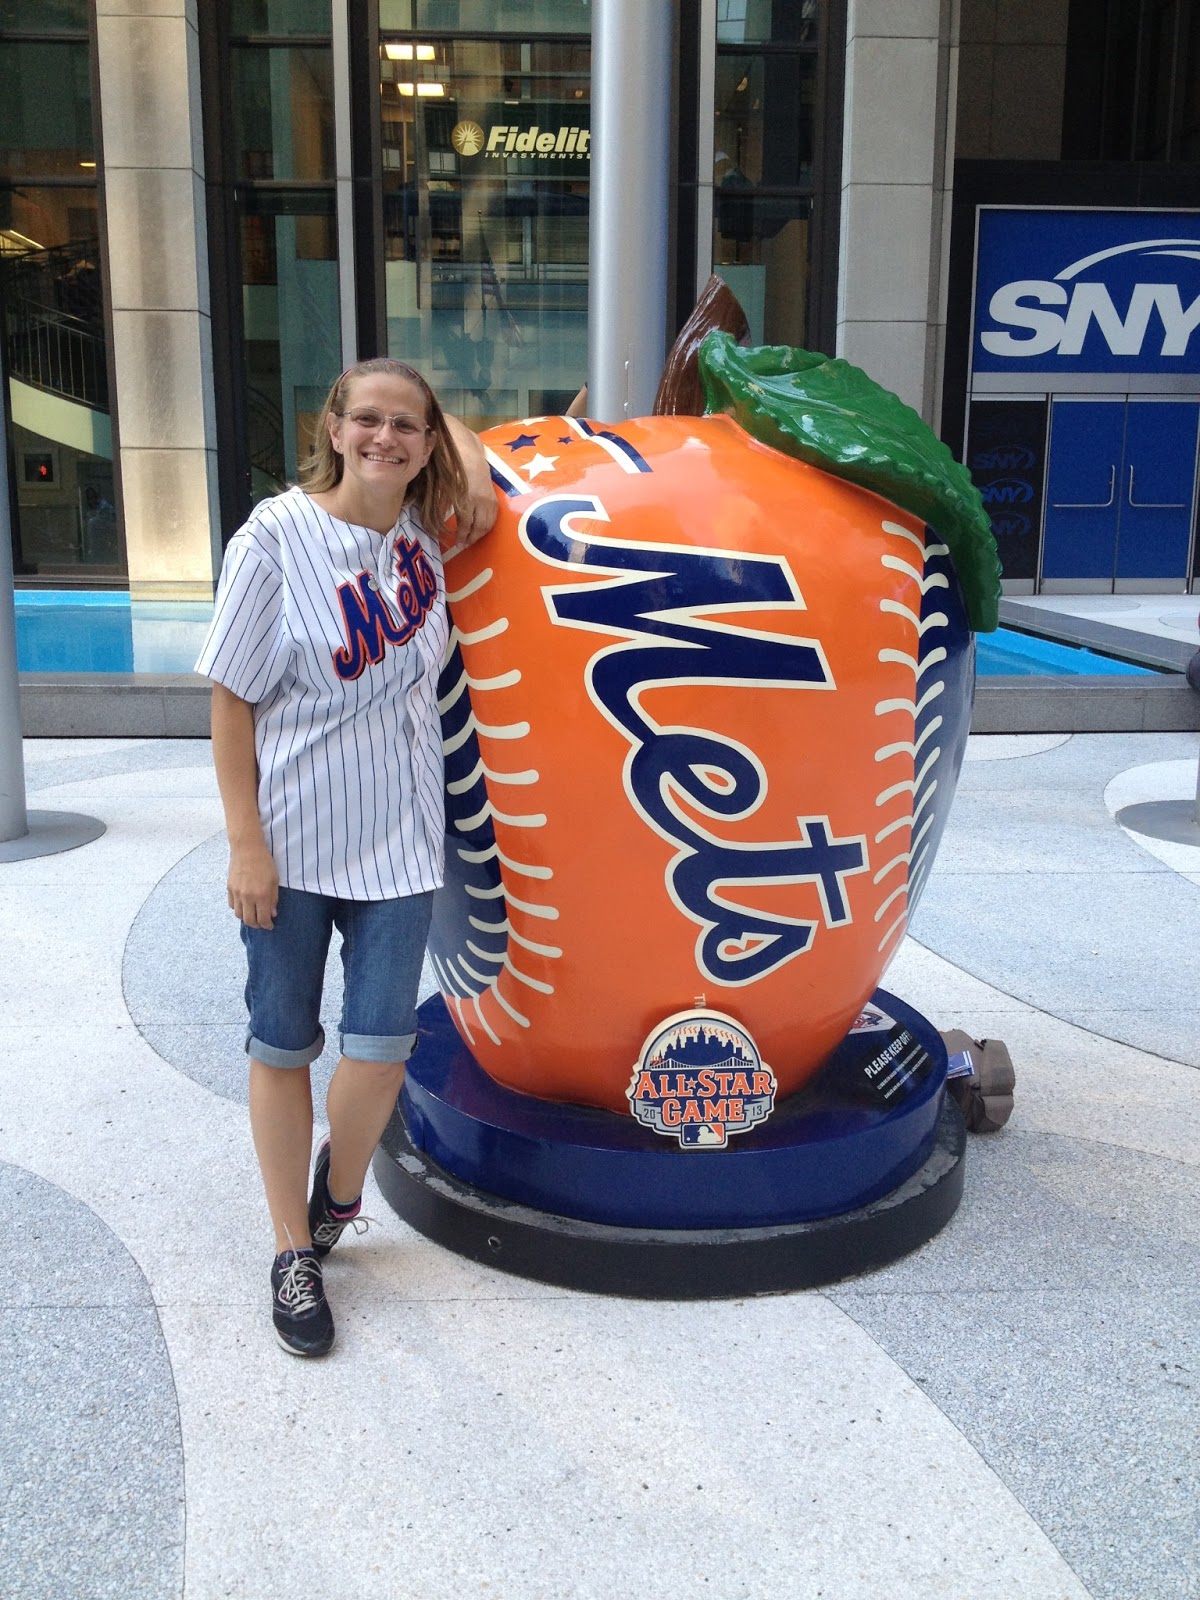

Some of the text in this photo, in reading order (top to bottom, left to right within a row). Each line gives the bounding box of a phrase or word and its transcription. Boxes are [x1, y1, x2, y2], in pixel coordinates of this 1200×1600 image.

[486, 126, 591, 153] Fidelit
[981, 280, 1200, 357] SNY
[973, 452, 1025, 469] SNY
[332, 534, 437, 681] Mets
[518, 493, 870, 987] Mets
[864, 1049, 893, 1079] PLEASE
[887, 1038, 903, 1057] KEEP
[662, 1098, 745, 1126] GAME
